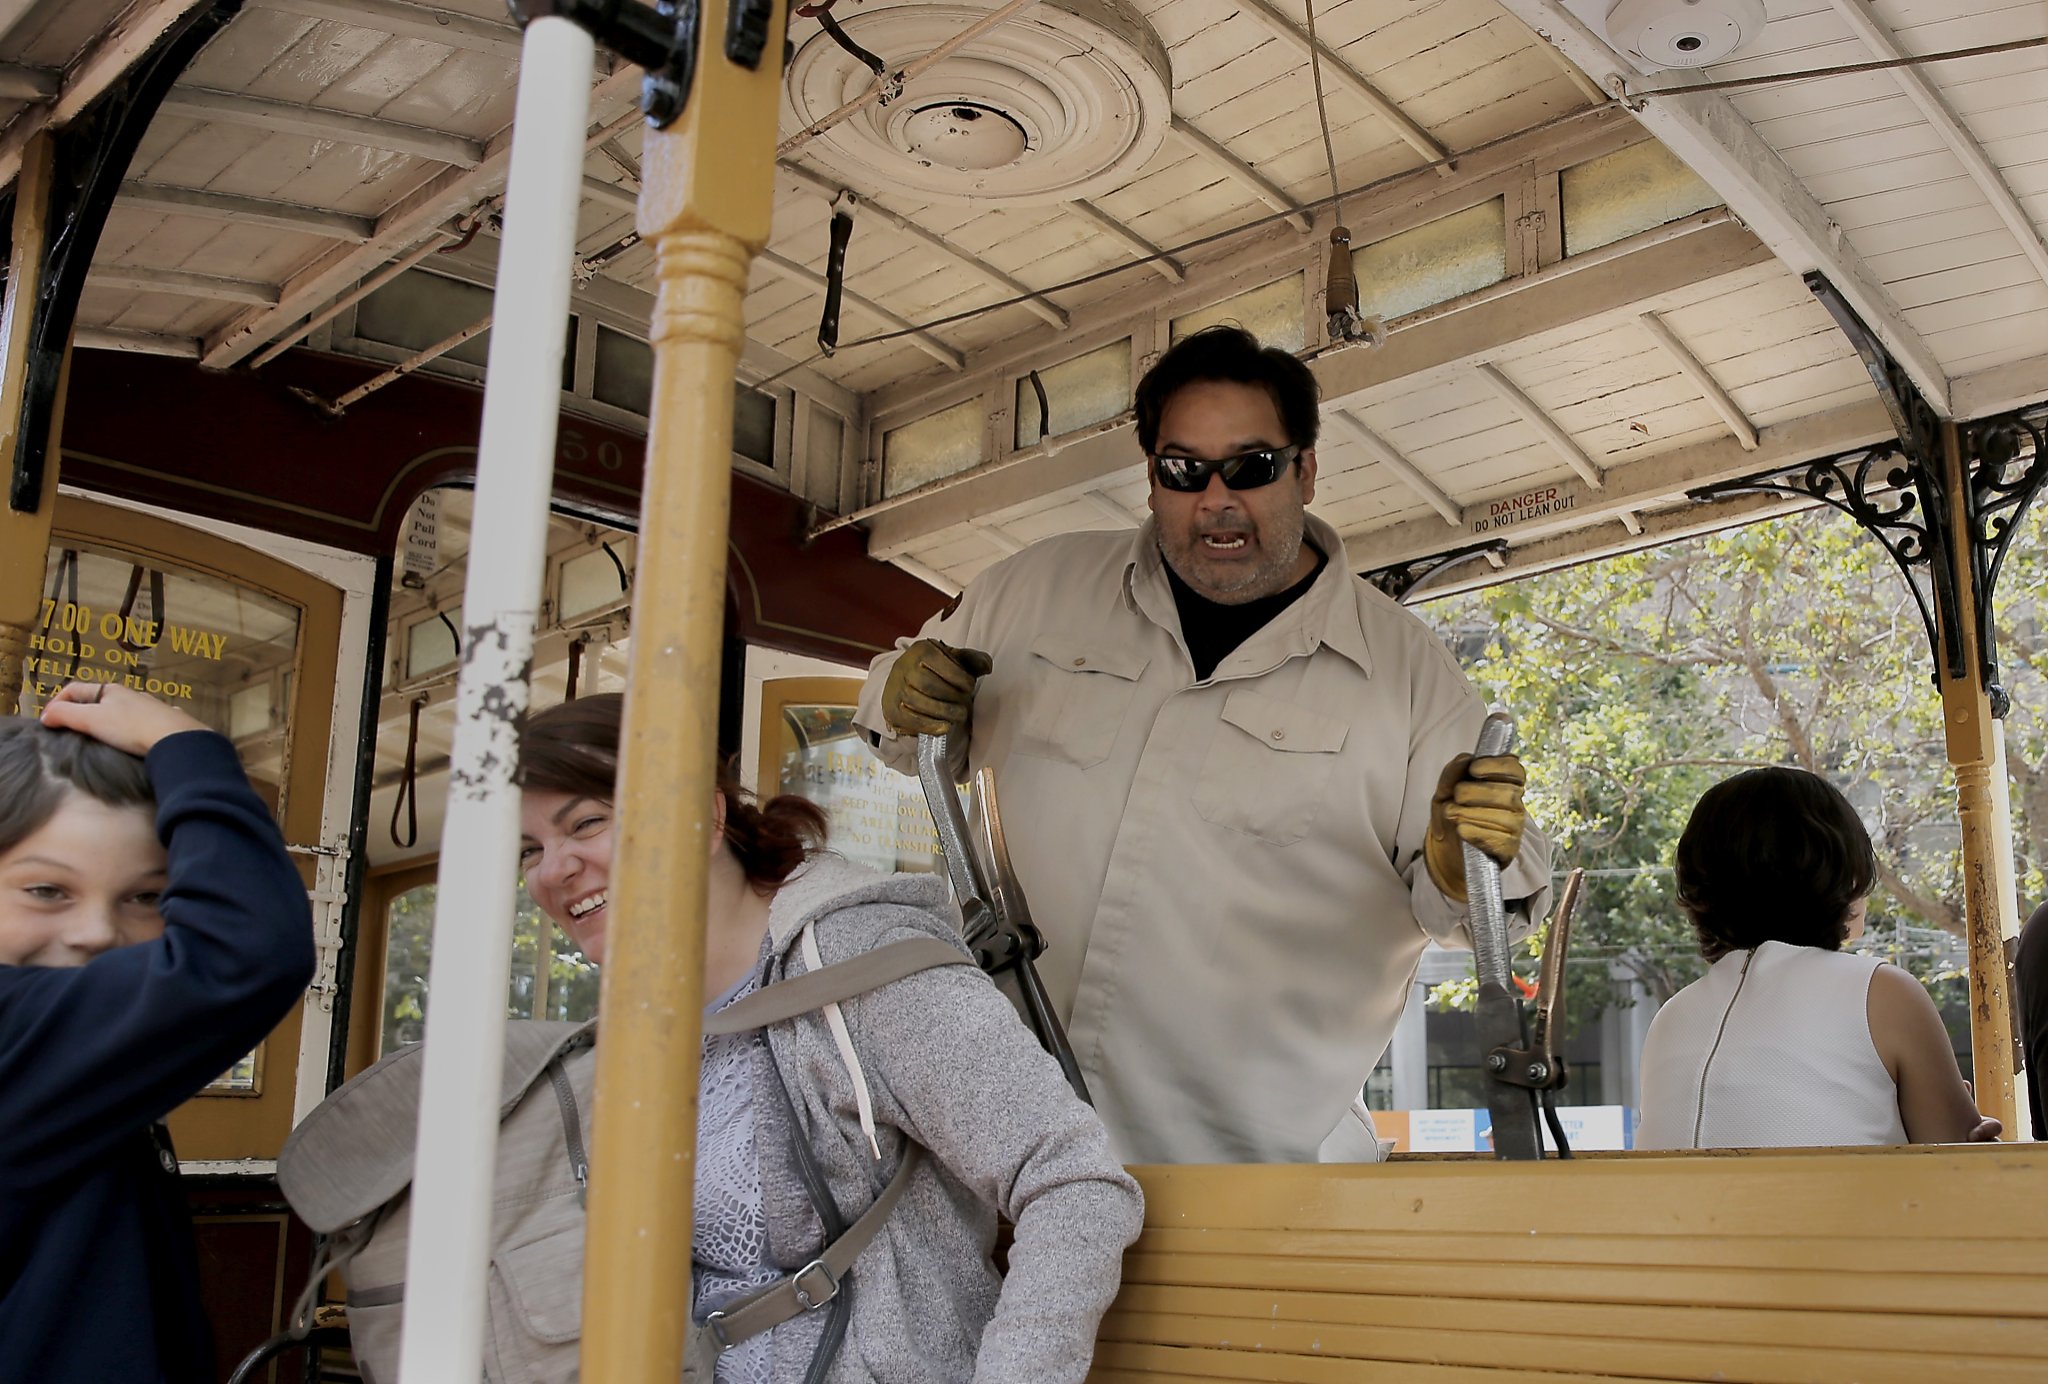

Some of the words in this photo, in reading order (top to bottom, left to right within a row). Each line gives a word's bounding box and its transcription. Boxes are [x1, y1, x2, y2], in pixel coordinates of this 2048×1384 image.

[421, 494, 435, 506] Do
[1490, 488, 1557, 516] DANGER
[418, 507, 435, 520] Not
[1475, 520, 1489, 532] DO
[1494, 512, 1515, 528] NOT
[1520, 502, 1550, 521] LEAN
[1554, 496, 1575, 511] OUT
[414, 521, 435, 535] Pull
[408, 534, 436, 549] Cord
[100, 613, 158, 648] ONE
[170, 625, 227, 661] WAY
[29, 634, 95, 658] HOLD
[104, 650, 139, 667] ON
[26, 656, 117, 683] YELLOW
[124, 674, 192, 699] FLOOR
[872, 801, 916, 817] YELLOW
[852, 832, 871, 844] NO
[899, 823, 939, 838] CLEAR
